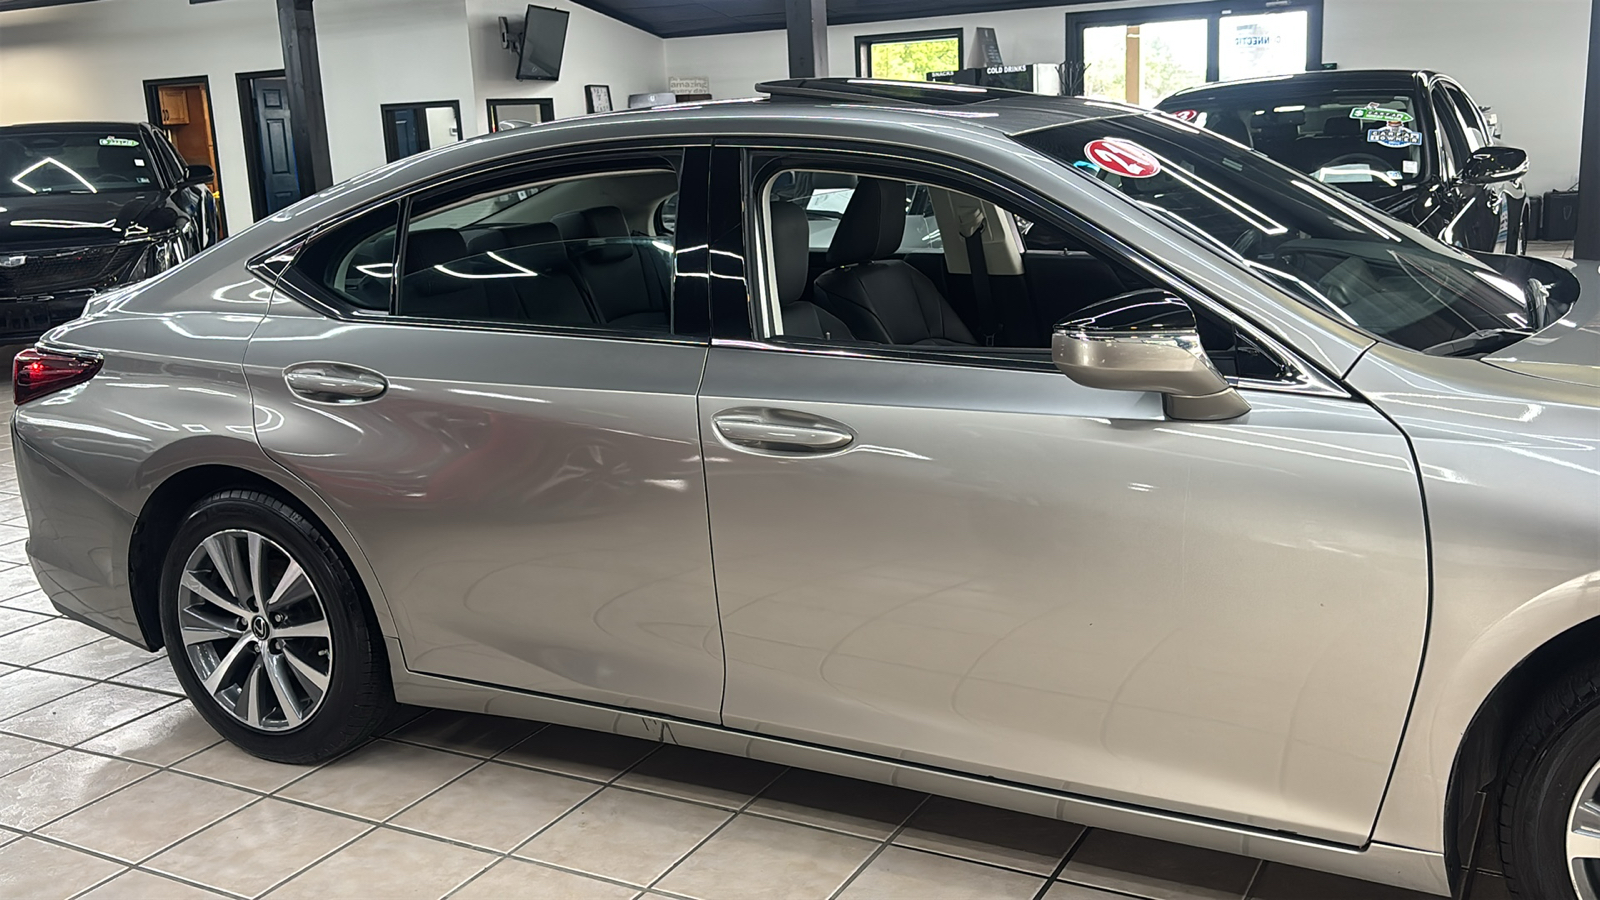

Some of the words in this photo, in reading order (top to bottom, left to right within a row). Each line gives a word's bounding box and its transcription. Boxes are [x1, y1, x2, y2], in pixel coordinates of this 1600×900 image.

[987, 66, 1003, 74] COLD
[1004, 65, 1026, 73] DRINKS
[672, 80, 707, 89] amazing
